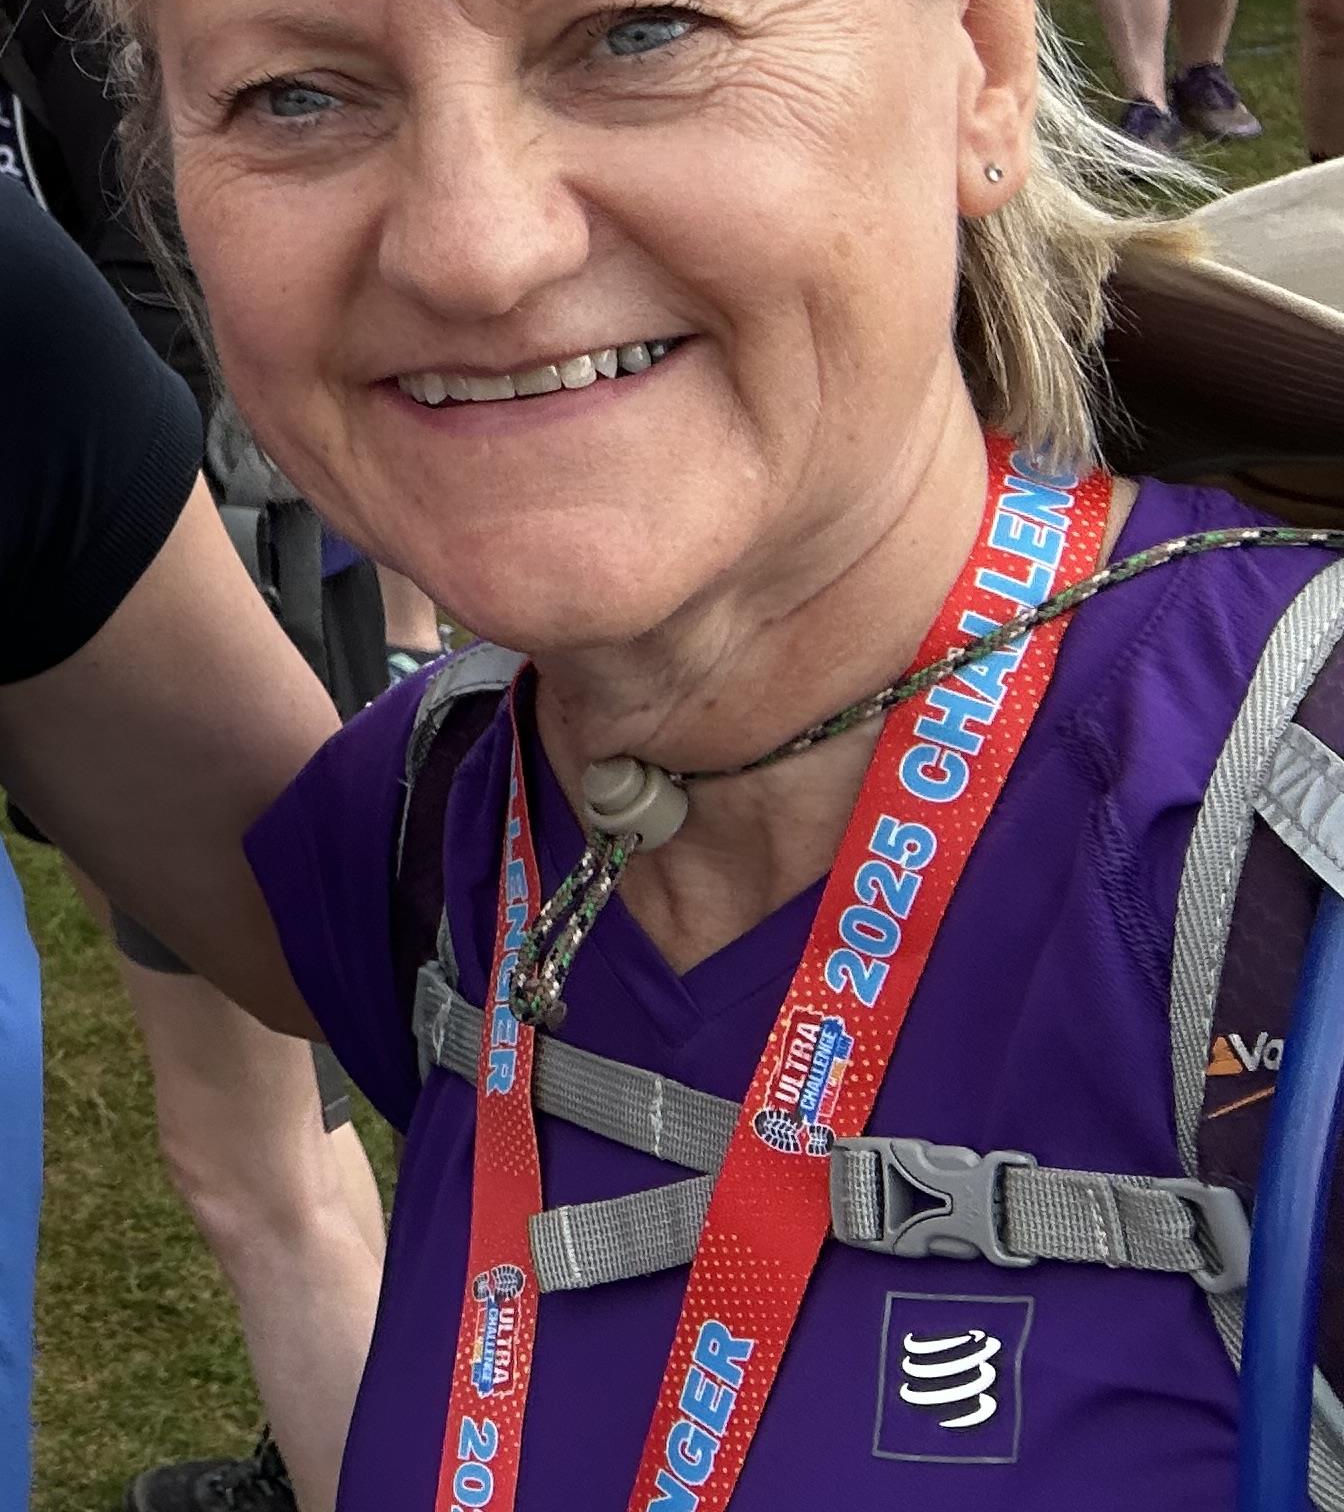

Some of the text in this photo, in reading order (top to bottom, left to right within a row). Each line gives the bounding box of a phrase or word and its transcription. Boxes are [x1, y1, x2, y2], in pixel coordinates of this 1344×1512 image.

[824, 812, 938, 1009] 2025
[775, 1018, 820, 1110] ULTRA
[799, 1021, 841, 1119] CHALLENGE
[480, 1305, 502, 1383] CHALLENGE
[495, 1305, 518, 1388] ULTRA
[450, 1416, 500, 1512] 20
